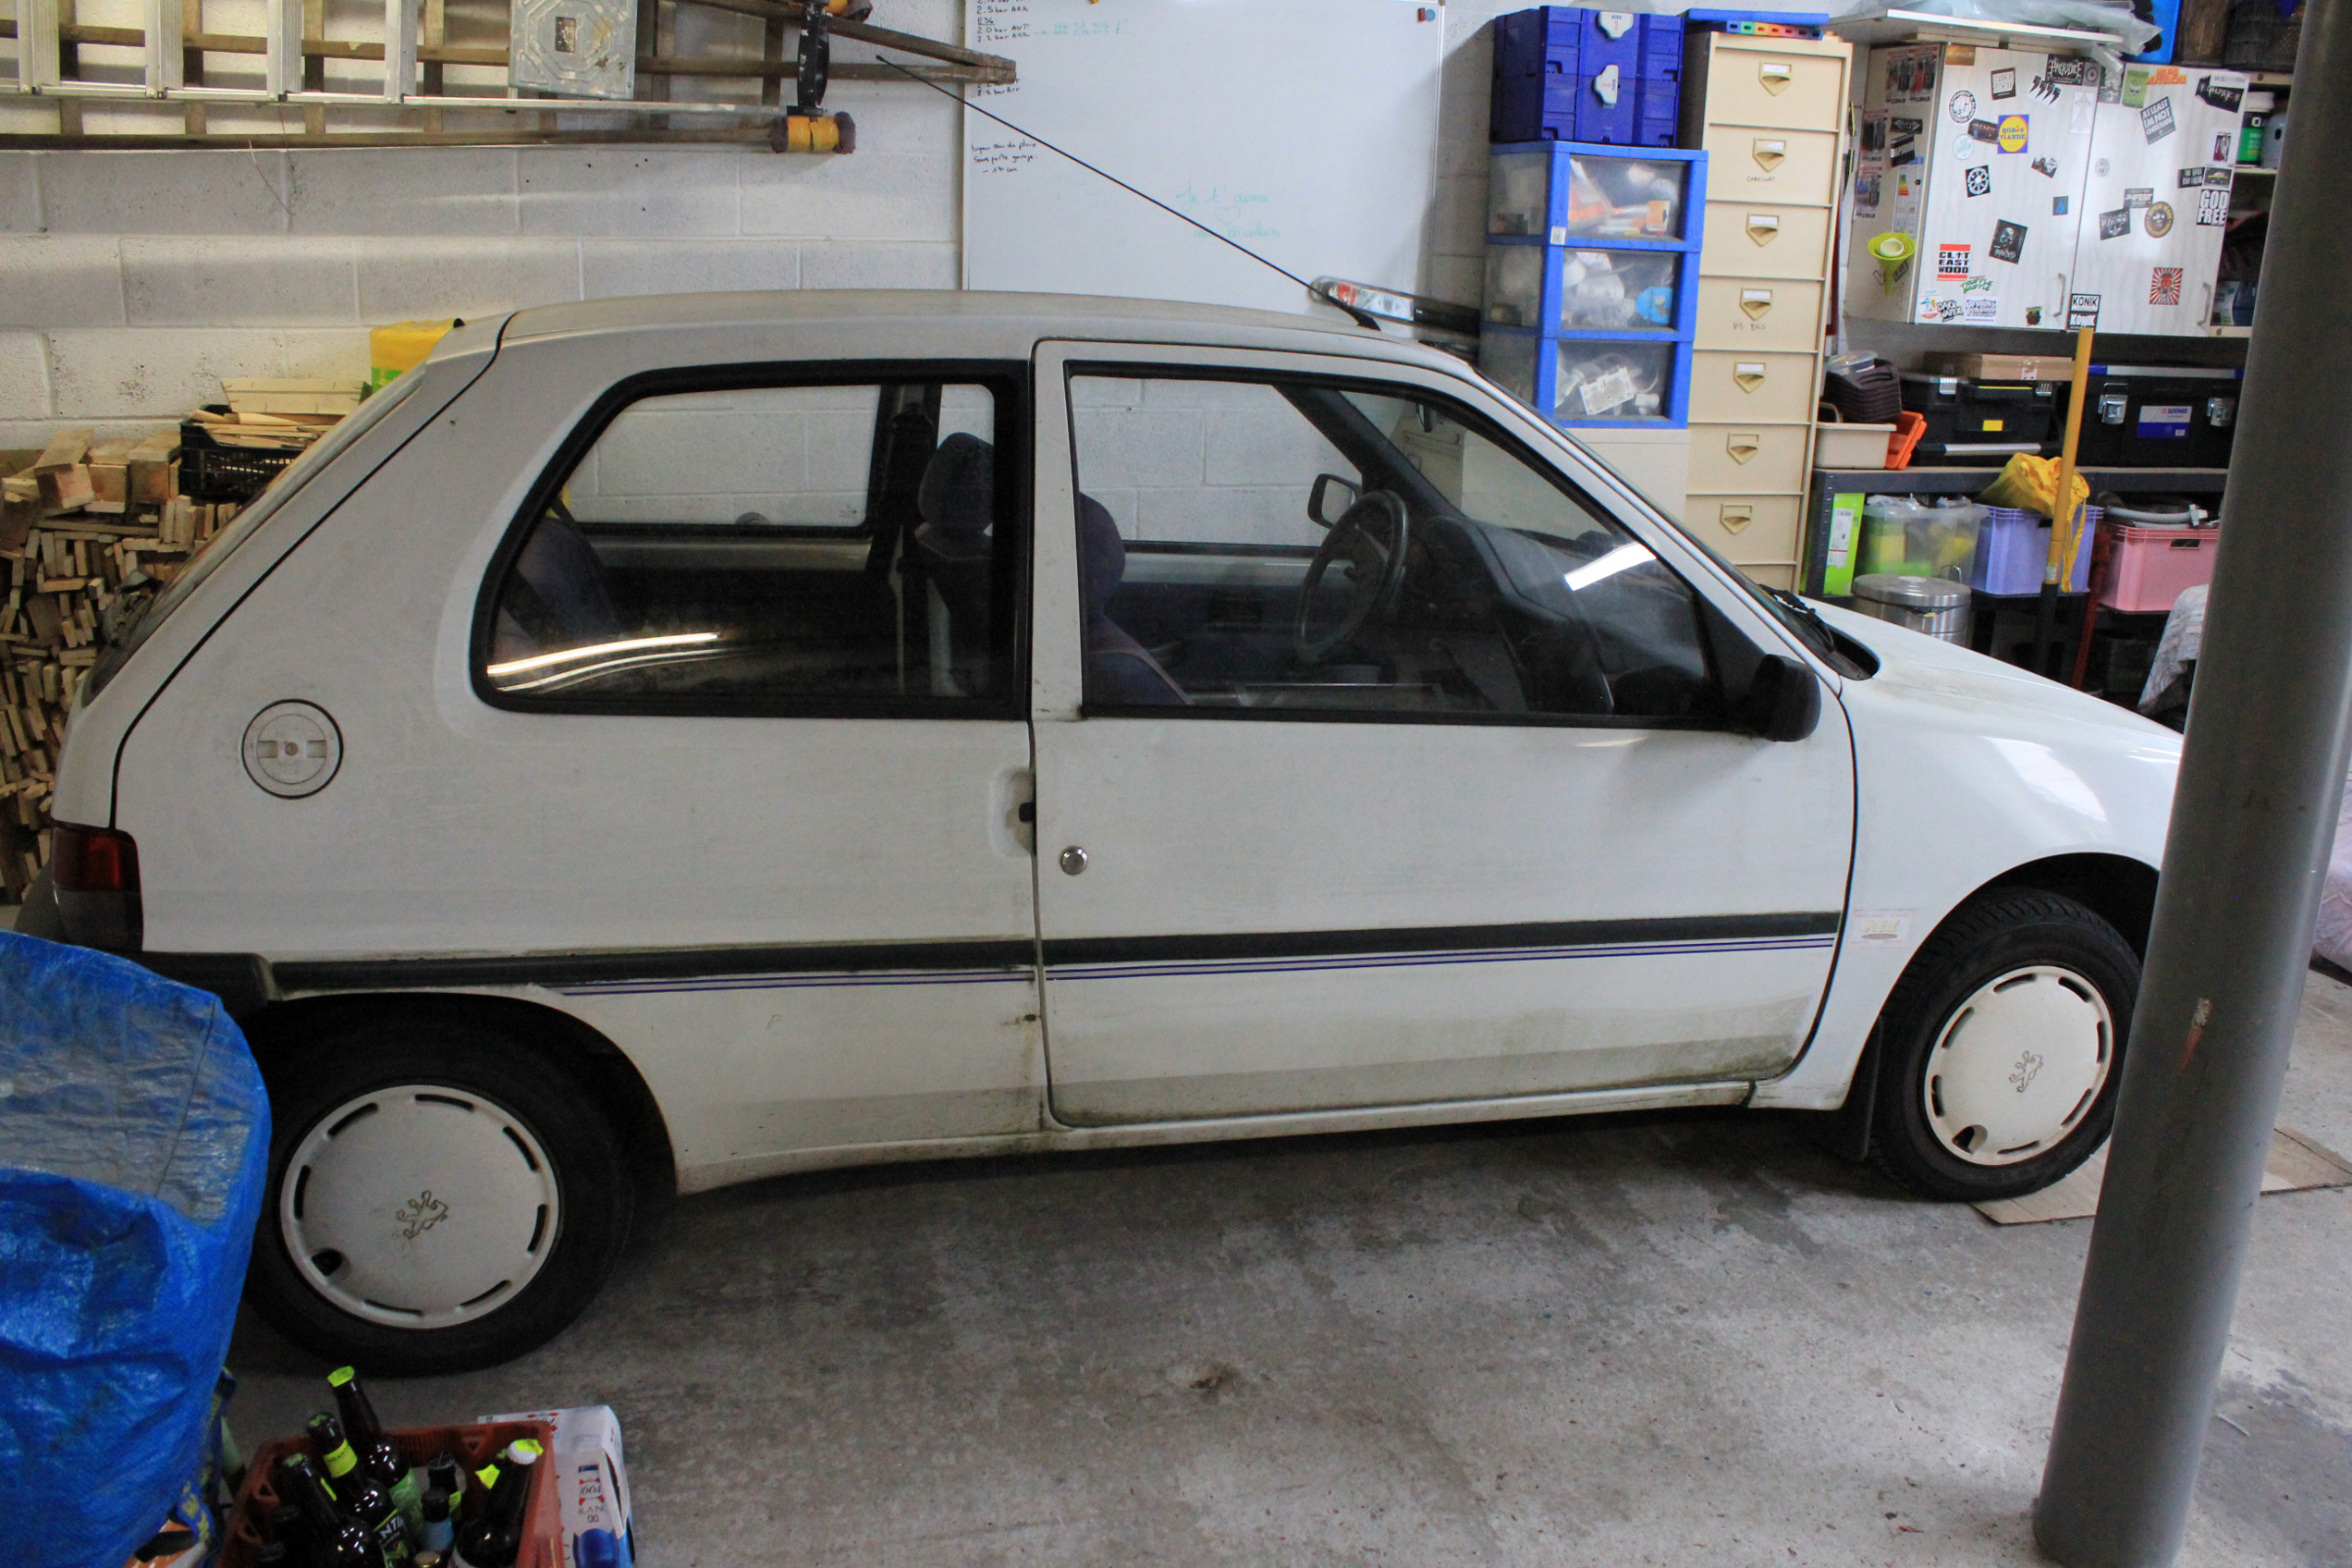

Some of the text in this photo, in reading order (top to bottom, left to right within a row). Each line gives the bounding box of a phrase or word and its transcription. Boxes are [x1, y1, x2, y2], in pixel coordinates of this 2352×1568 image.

[2199, 189, 2230, 210] GOD
[2196, 207, 2228, 224] FREE
[1937, 266, 1969, 274] WOOD
[2072, 296, 2098, 307] KONIK
